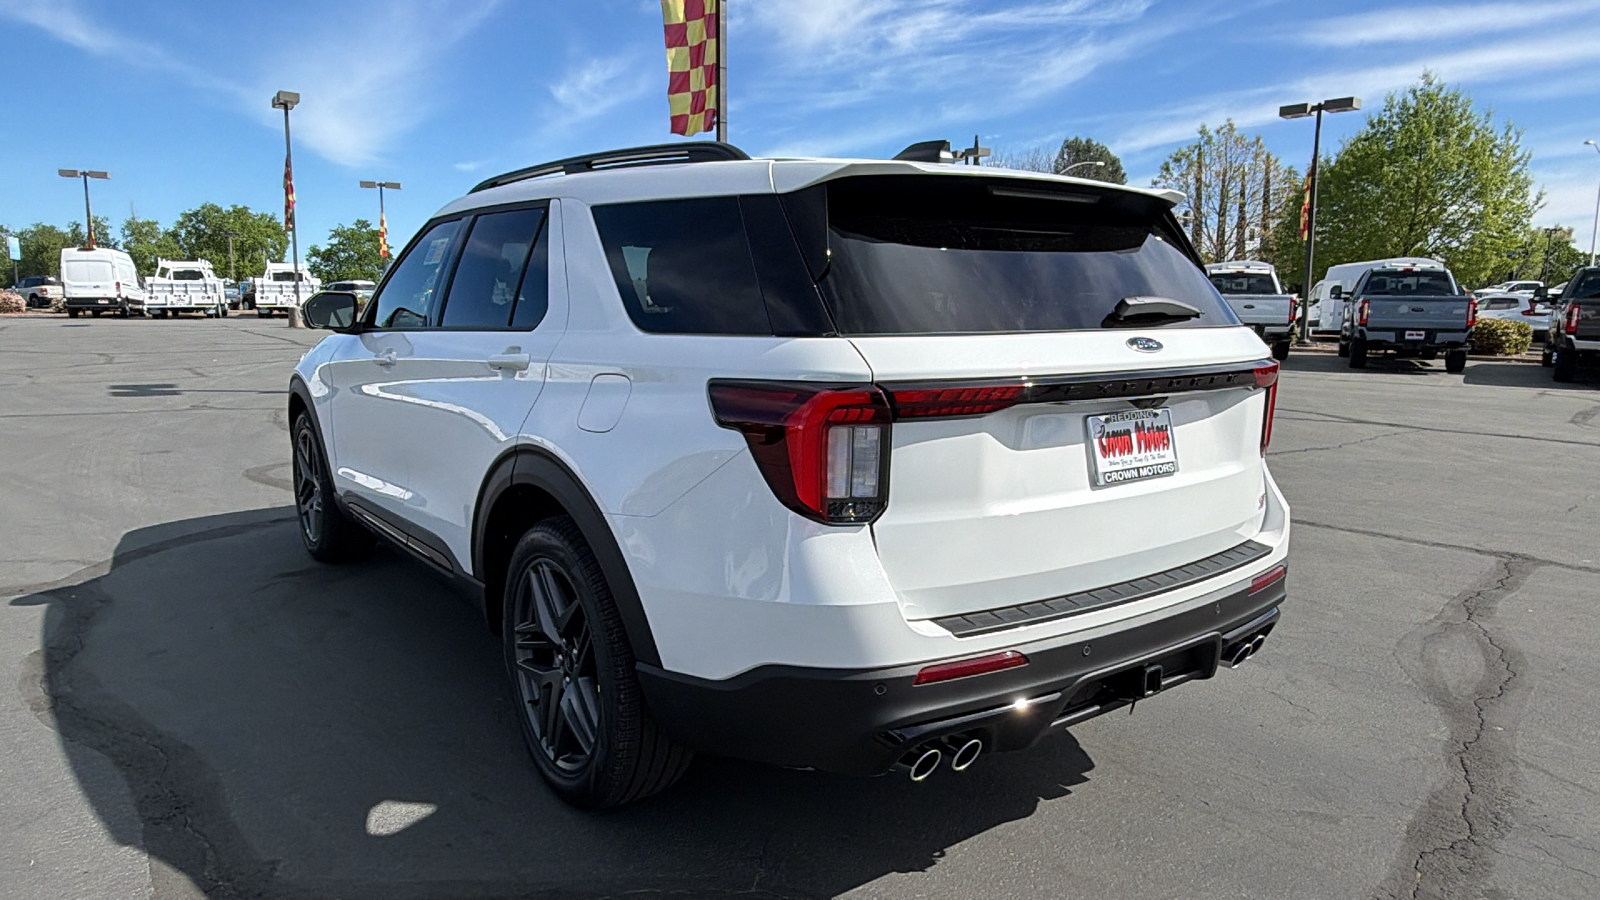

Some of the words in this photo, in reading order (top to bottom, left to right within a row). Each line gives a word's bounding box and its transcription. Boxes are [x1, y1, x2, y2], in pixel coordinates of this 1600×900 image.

[1111, 410, 1153, 423] REDDING
[1098, 424, 1133, 459] Crown
[1135, 420, 1170, 454] Motors
[1105, 467, 1138, 482] CROWN
[1140, 463, 1175, 478] MOTORS
